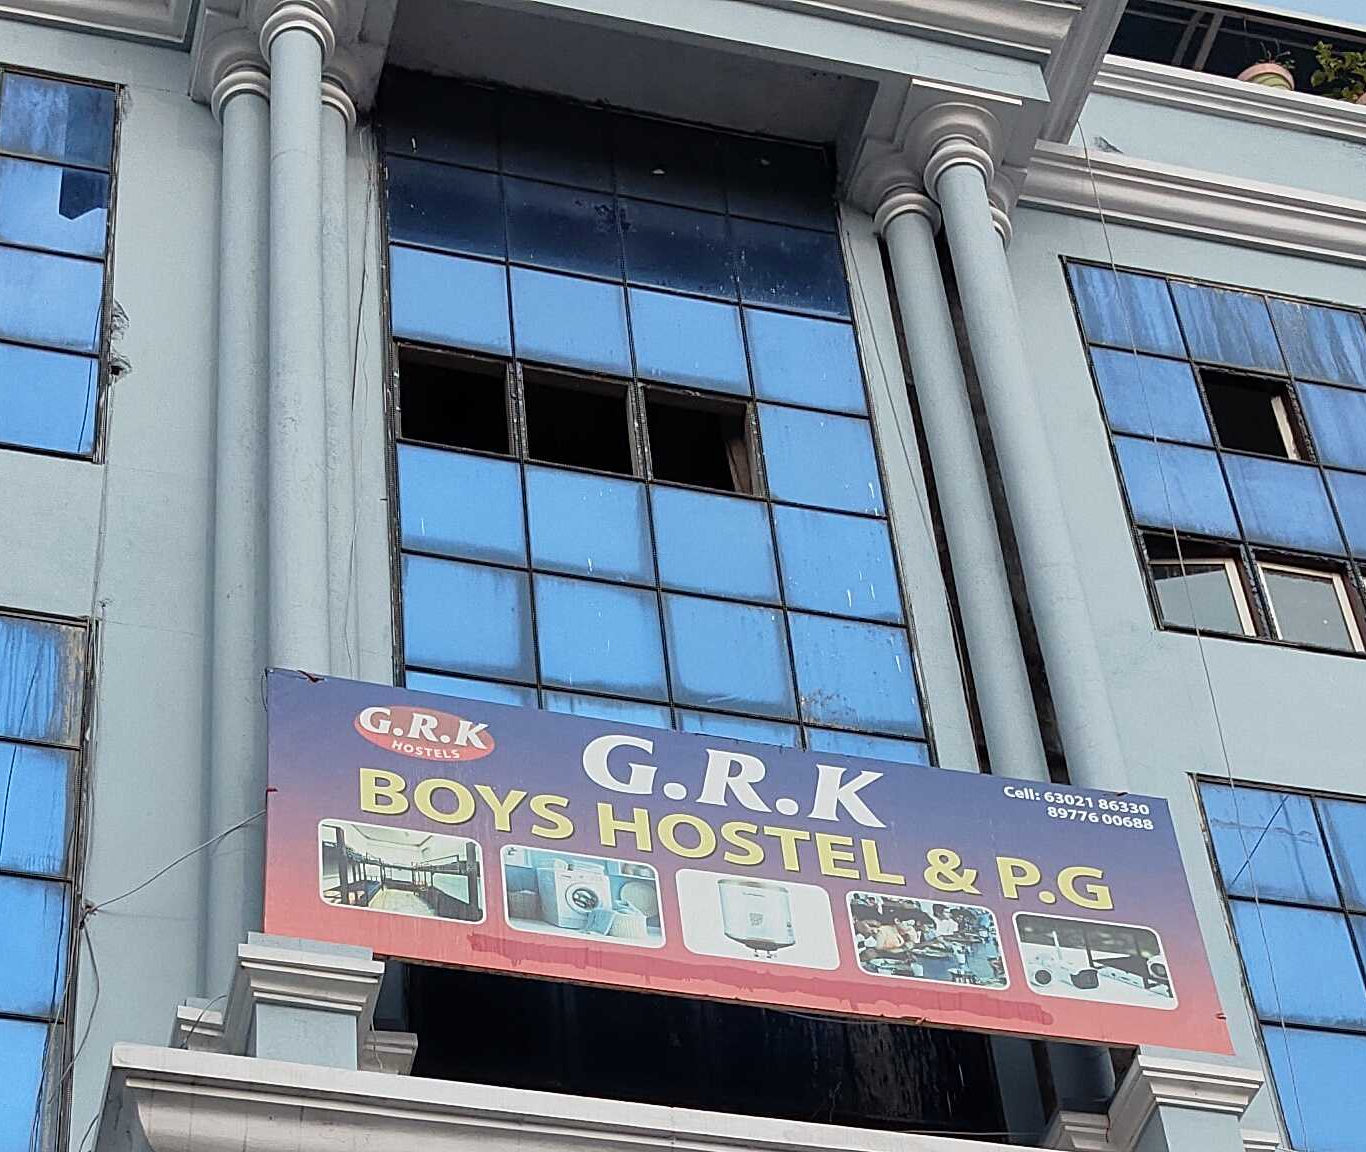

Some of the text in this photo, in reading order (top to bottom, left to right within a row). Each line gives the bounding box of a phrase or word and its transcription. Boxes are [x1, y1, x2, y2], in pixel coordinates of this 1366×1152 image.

[359, 706, 489, 750] G.R.K
[391, 740, 461, 760] HOSTELS
[582, 734, 887, 828] G.R.K
[1003, 786, 1150, 815] Cell: 63021 86330
[1047, 806, 1154, 830] 89776 00688
[359, 767, 1115, 910] BOYS HOSTEL & P.G
